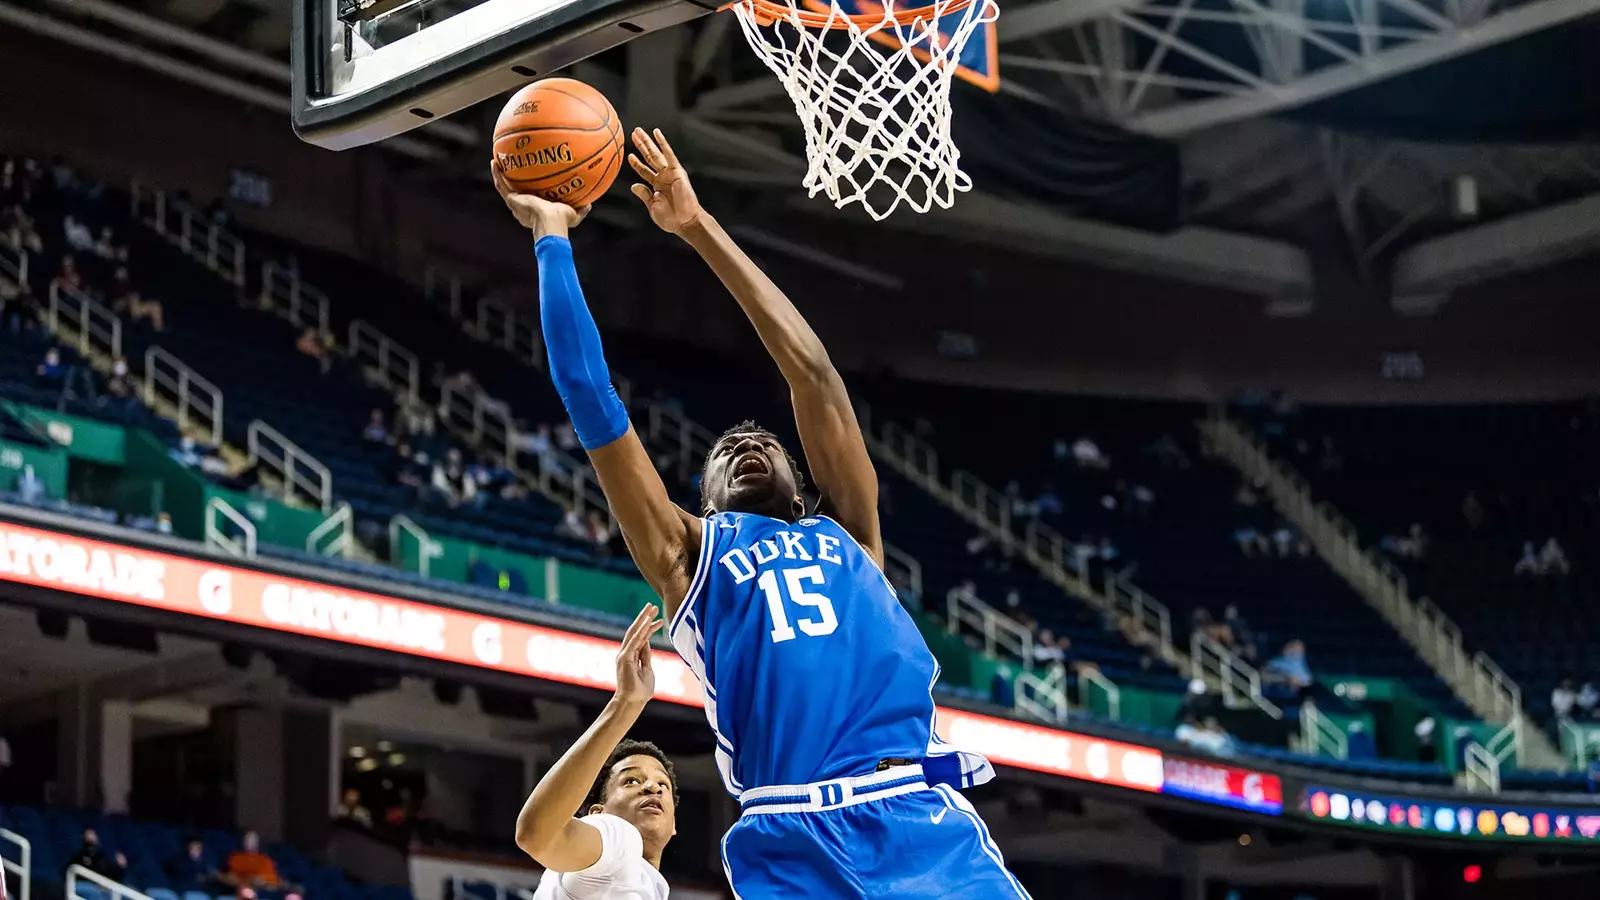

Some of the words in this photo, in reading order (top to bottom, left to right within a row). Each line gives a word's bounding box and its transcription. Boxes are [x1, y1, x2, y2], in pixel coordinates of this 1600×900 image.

[497, 142, 573, 173] SPALDING
[540, 177, 583, 201] 000
[719, 531, 842, 585] DUKE
[198, 568, 232, 615] G
[758, 565, 839, 643] 15
[818, 783, 843, 807] D
